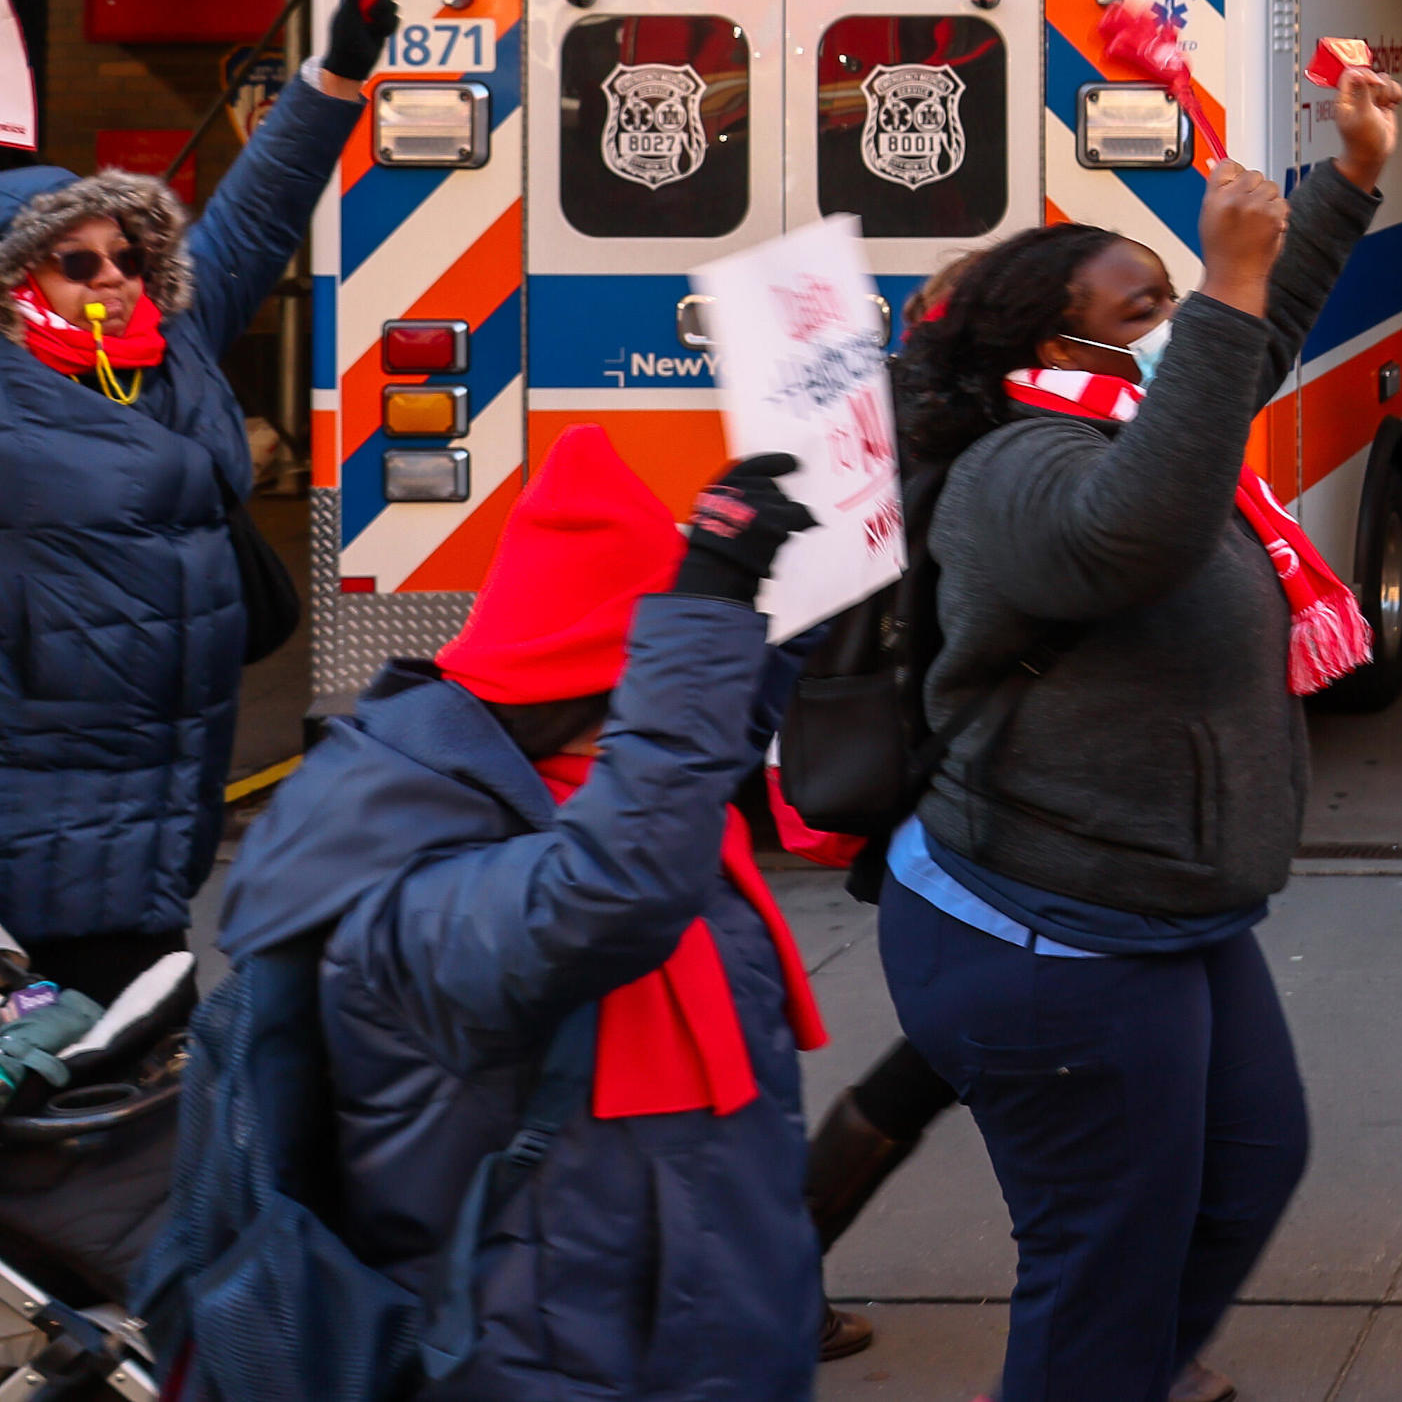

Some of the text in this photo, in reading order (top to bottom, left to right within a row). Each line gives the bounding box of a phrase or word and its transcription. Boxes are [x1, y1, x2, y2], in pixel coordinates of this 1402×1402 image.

[386, 24, 482, 67] 1871
[629, 136, 675, 152] 8027
[888, 136, 934, 152] 8001
